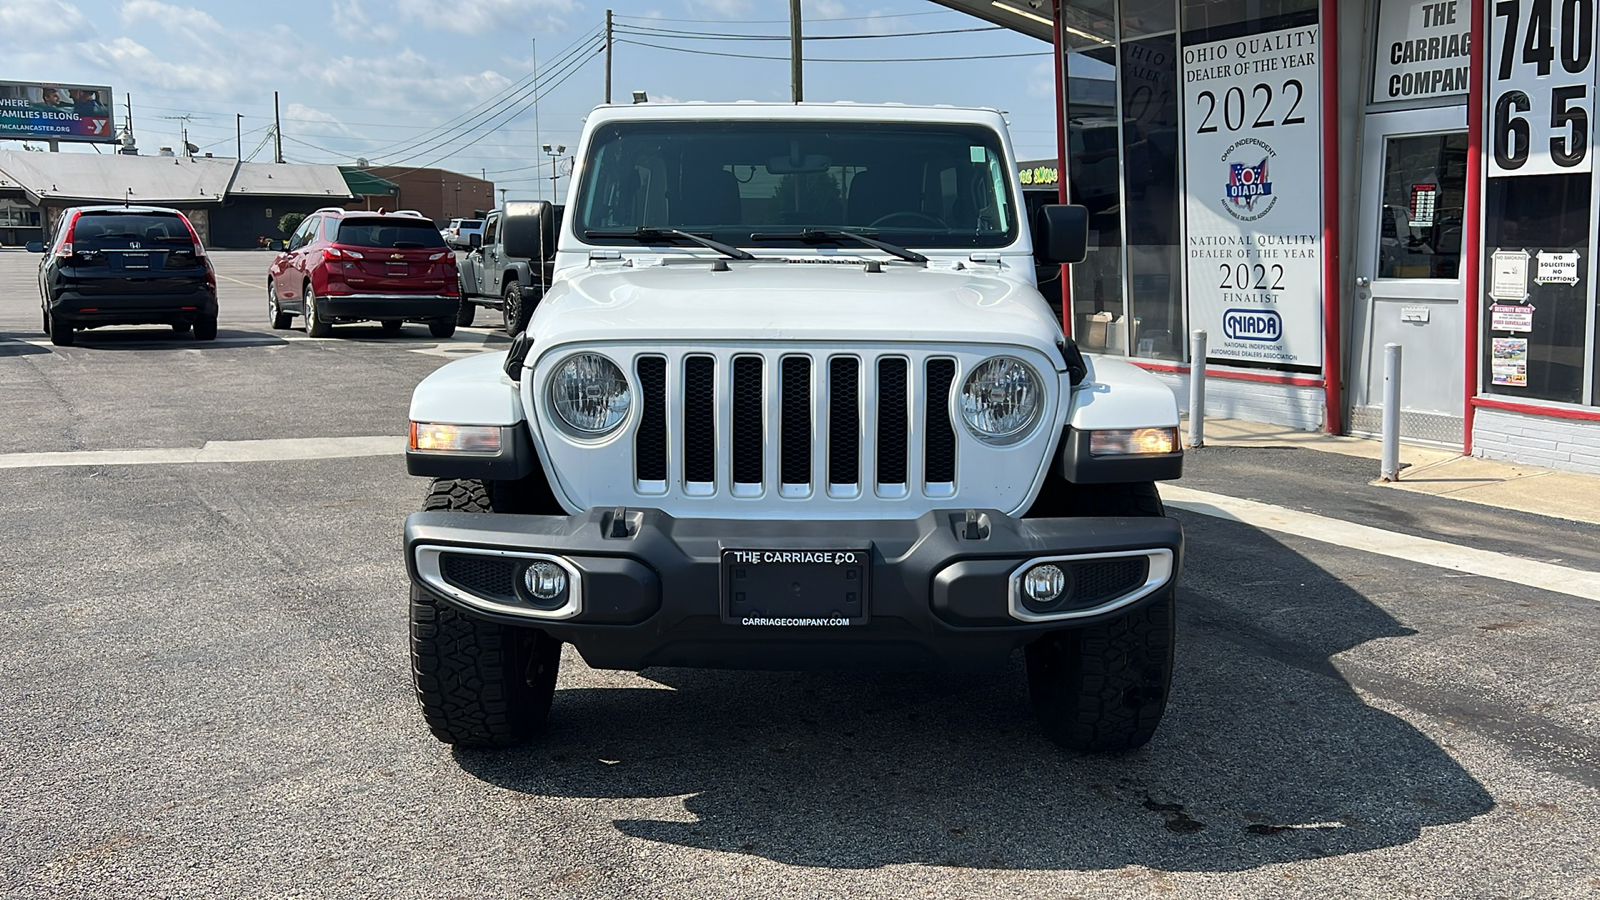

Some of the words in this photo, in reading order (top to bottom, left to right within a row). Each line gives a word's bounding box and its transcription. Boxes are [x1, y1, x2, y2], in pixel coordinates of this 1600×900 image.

[1422, 1, 1457, 28] THE
[1185, 45, 1228, 64] OHIO
[1236, 29, 1318, 58] QUALITY
[1390, 32, 1471, 65] CARRIAG
[1496, 0, 1593, 80] 740
[1186, 65, 1232, 82] DEALER
[1234, 61, 1250, 76] OF
[1253, 58, 1278, 73] THE
[1281, 52, 1315, 69] YEAR
[1388, 66, 1470, 97] COMPAN
[42, 112, 83, 121] BELONG.
[1196, 79, 1306, 134] 2022
[1220, 145, 1235, 162] OHIO
[1235, 138, 1277, 158] INDEPENDENT
[1231, 183, 1265, 197] OIADA
[1220, 198, 1241, 220] AUTOMOBILE
[1257, 195, 1278, 219] ASSOCIATION
[1190, 235, 1252, 246] NATIONAL
[1258, 235, 1317, 247] QUALITY
[1191, 249, 1233, 259] DEALER
[1237, 249, 1252, 259] OF
[1256, 249, 1279, 259] THE
[1284, 249, 1315, 259] YEAR
[1219, 263, 1285, 290] 2022
[1223, 293, 1279, 303] FINALIST
[1227, 315, 1277, 335] NIADA
[1211, 349, 1240, 357] AUTOMOBILE
[1263, 352, 1298, 361] ASSOCIATION
[1249, 343, 1283, 352] INDEPENDENT
[734, 551, 761, 564] THE
[763, 551, 833, 564] CARRIAGE
[834, 551, 859, 565] CO.
[741, 617, 850, 627] CARRIAGECOMPANY.COM
